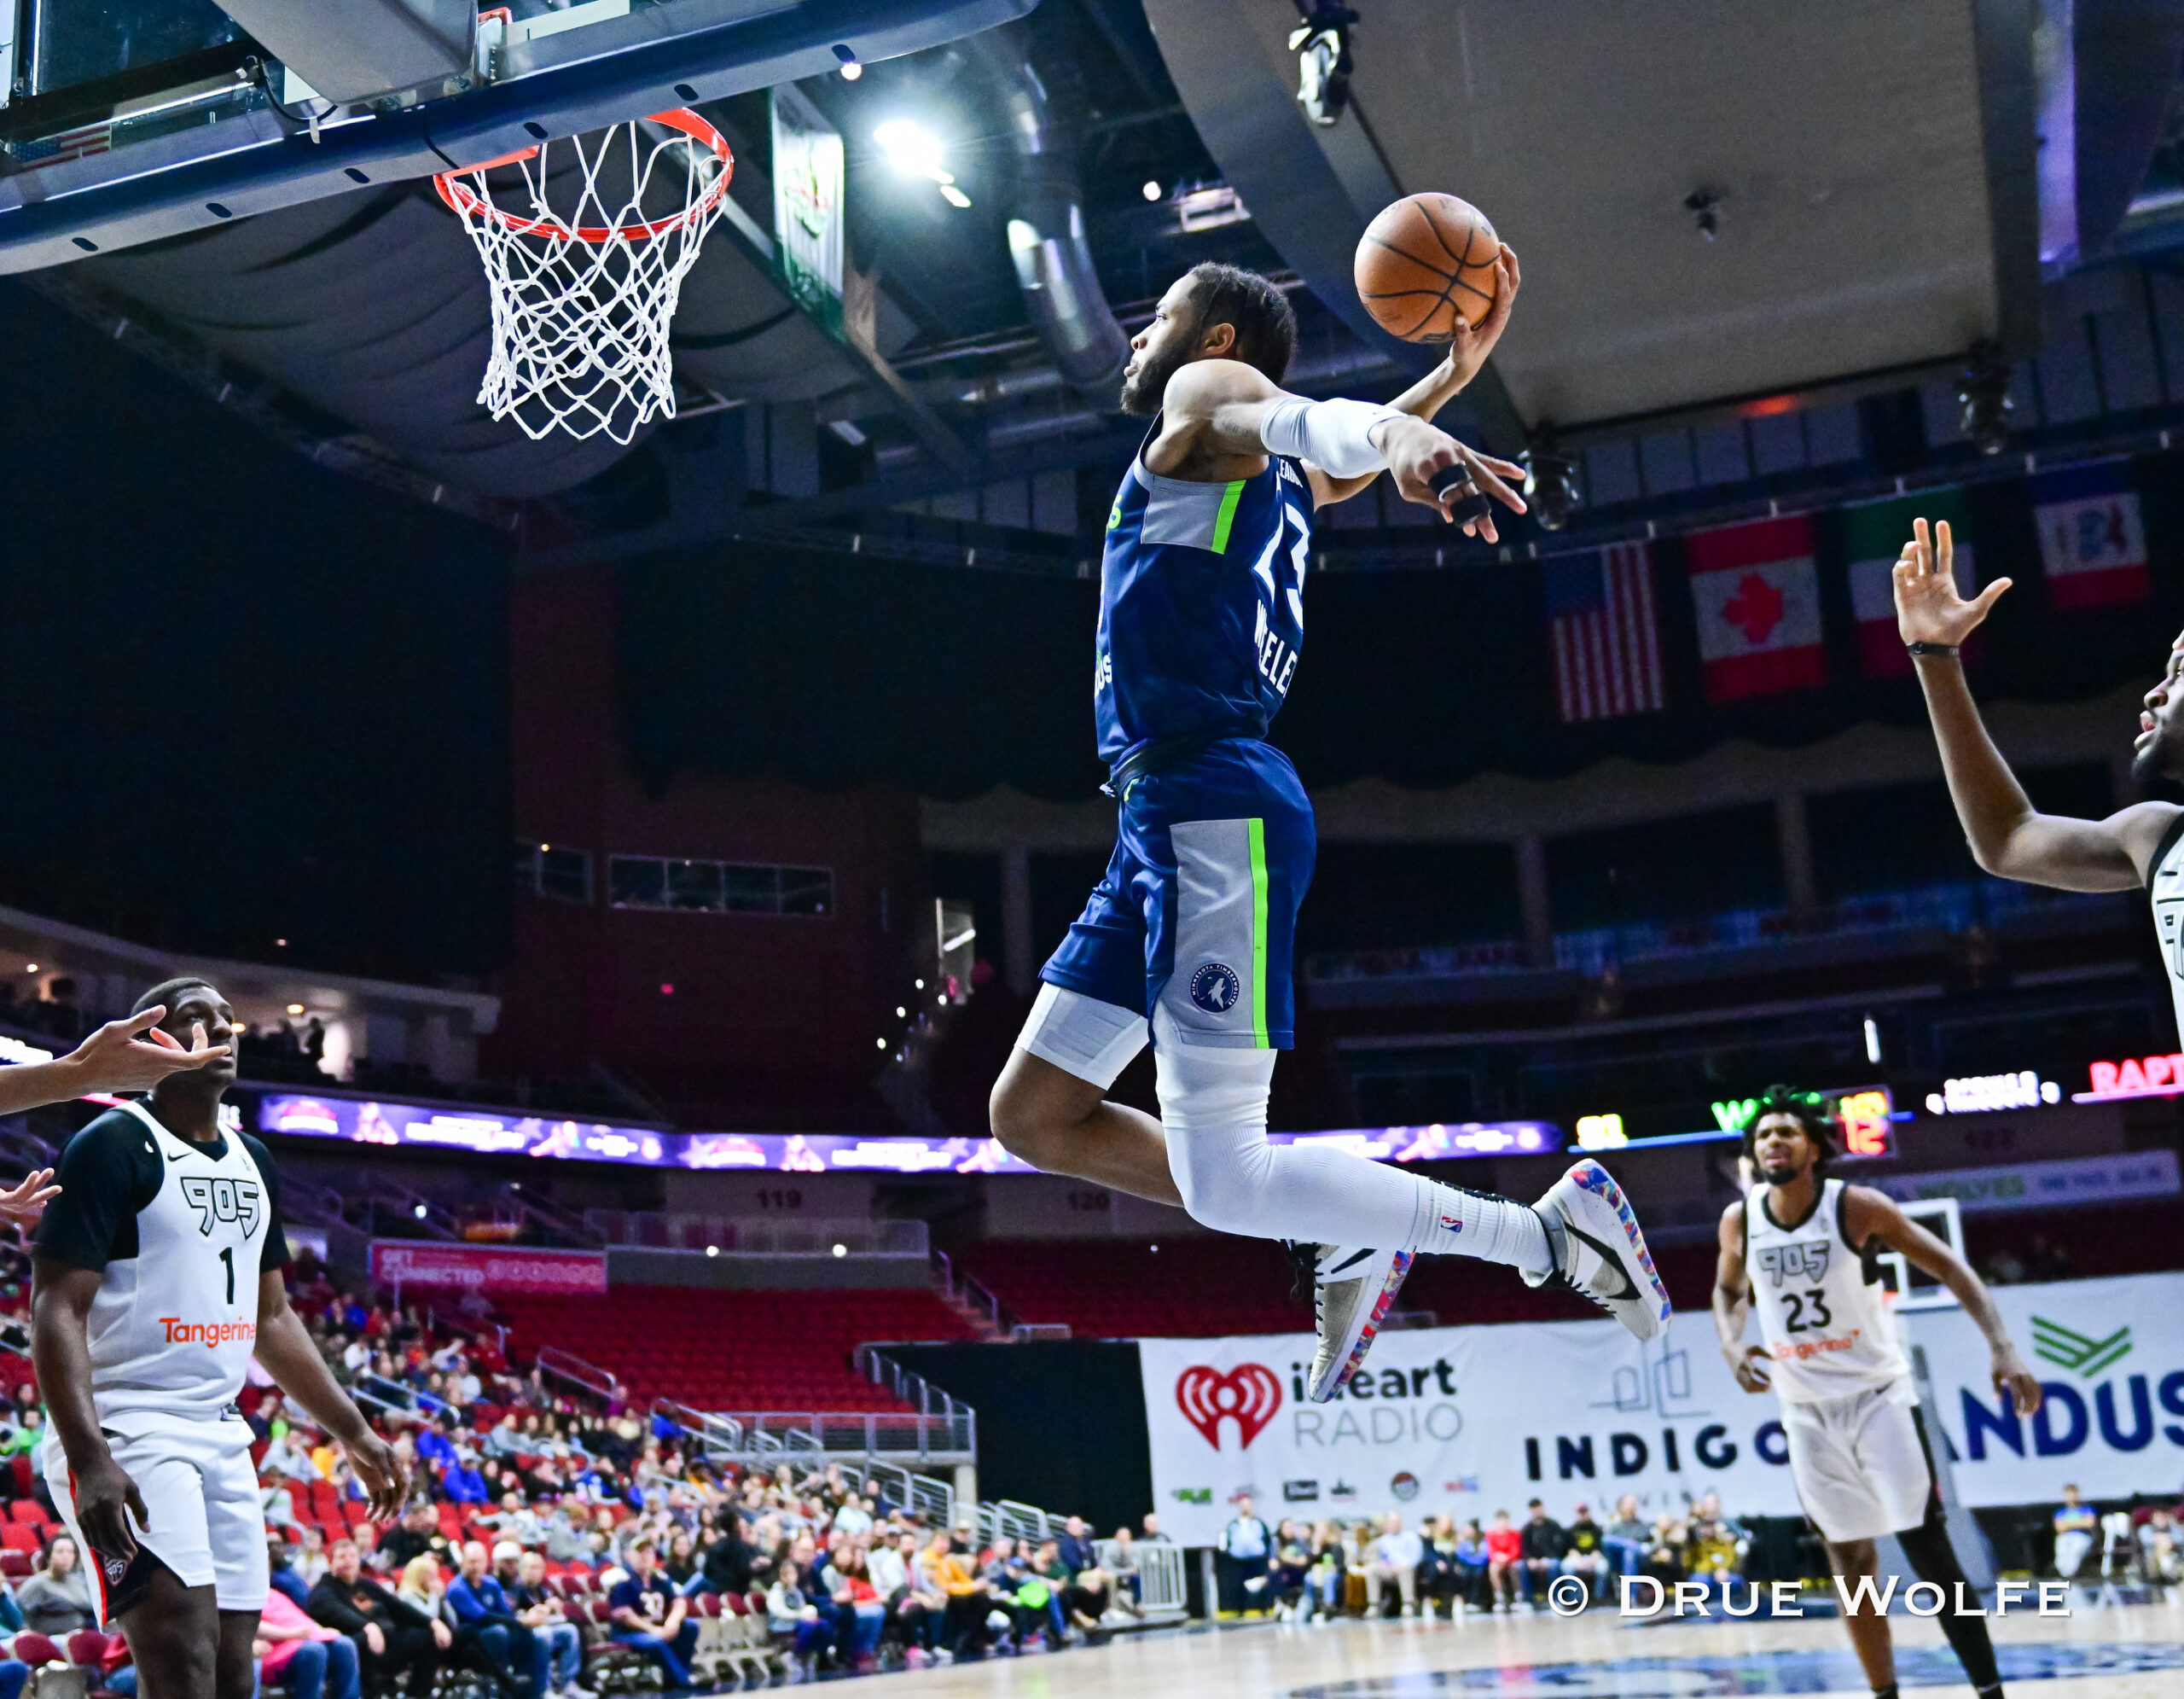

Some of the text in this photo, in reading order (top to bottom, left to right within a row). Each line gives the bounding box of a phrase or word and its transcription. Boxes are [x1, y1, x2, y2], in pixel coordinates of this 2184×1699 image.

[1191, 964, 1240, 1006] MINNESOTA TIMBERWOLVES
[180, 1176, 259, 1240] 905
[218, 1247, 235, 1305] 1
[1756, 1240, 1831, 1289] 905
[1780, 1289, 1832, 1334] 23
[1292, 1358, 1457, 1402] ieart
[1293, 1402, 1463, 1448] RADIO
[1525, 1419, 1791, 1481] INDIGO
